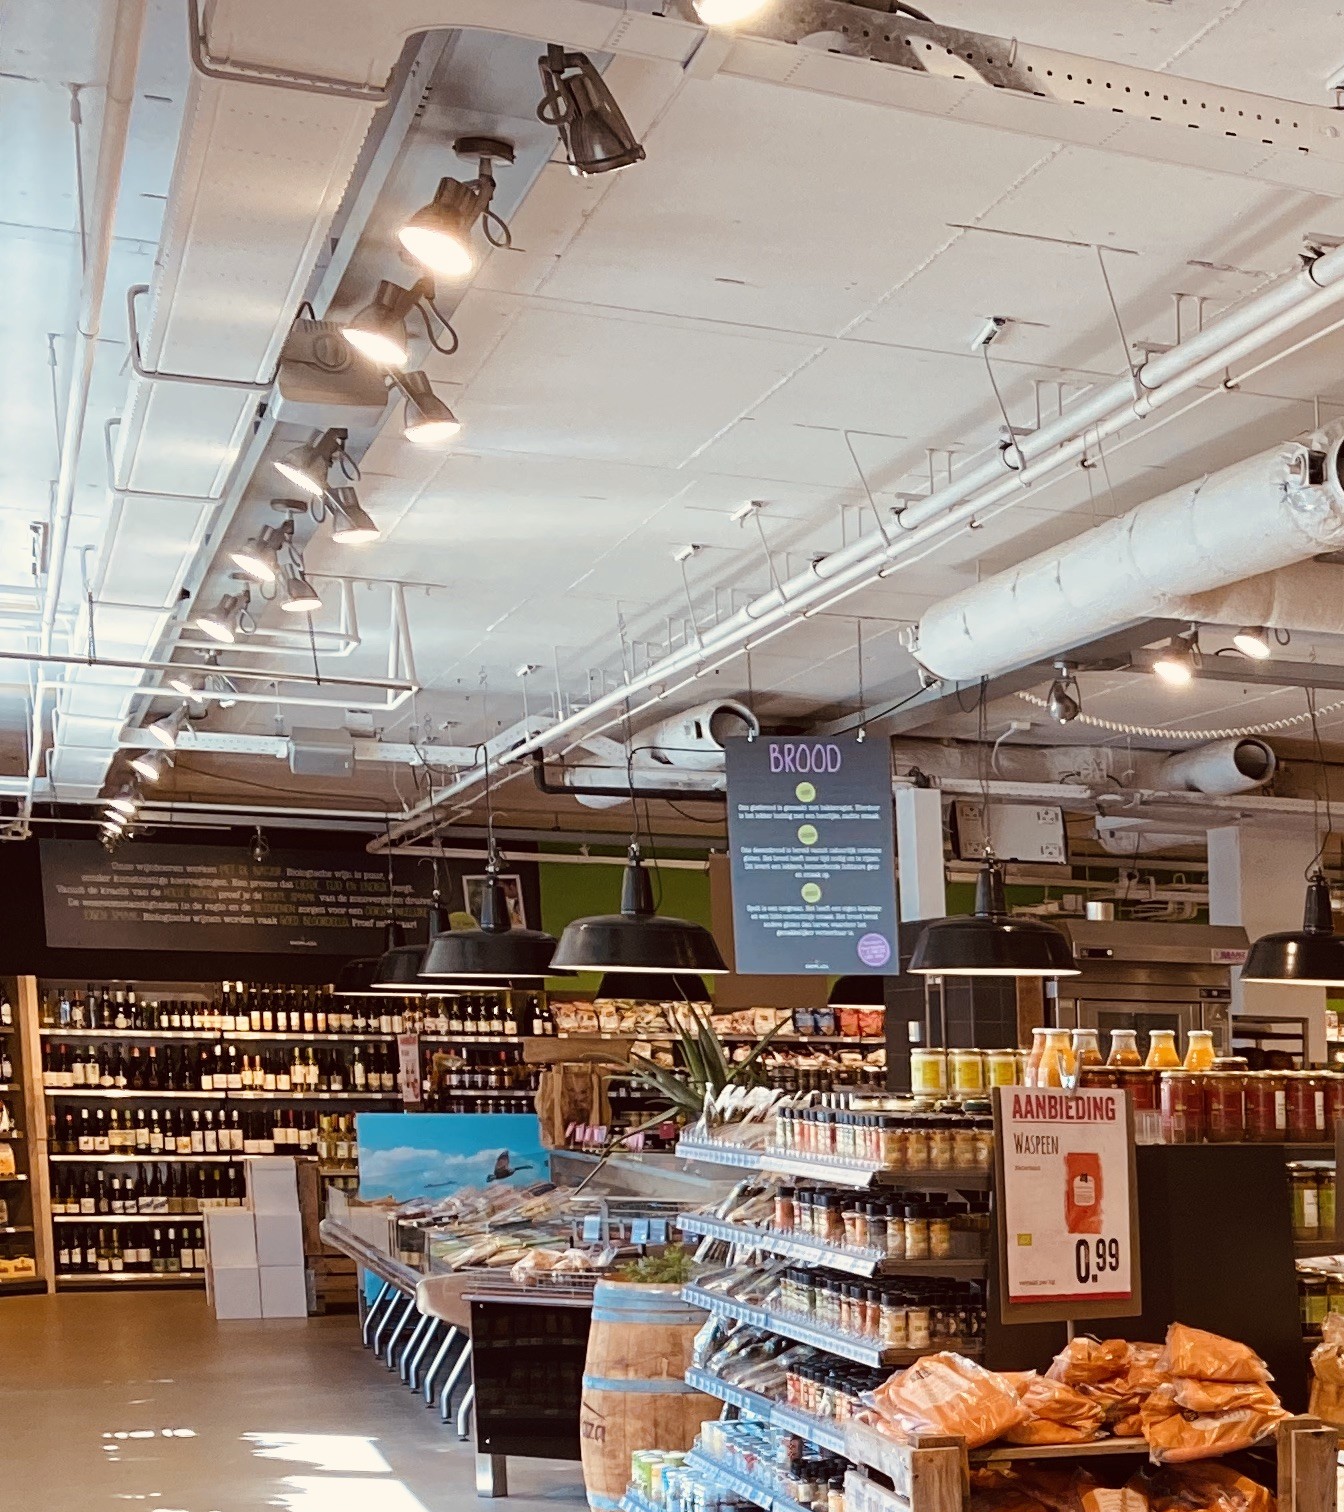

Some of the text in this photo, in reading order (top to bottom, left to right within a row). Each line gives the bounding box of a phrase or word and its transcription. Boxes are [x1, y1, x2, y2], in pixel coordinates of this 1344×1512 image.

[769, 743, 841, 773] BROOD
[1013, 1094, 1116, 1121] AANBIEDING
[1014, 1133, 1058, 1155] WASPEEN
[1075, 1238, 1119, 1284] 0.99
